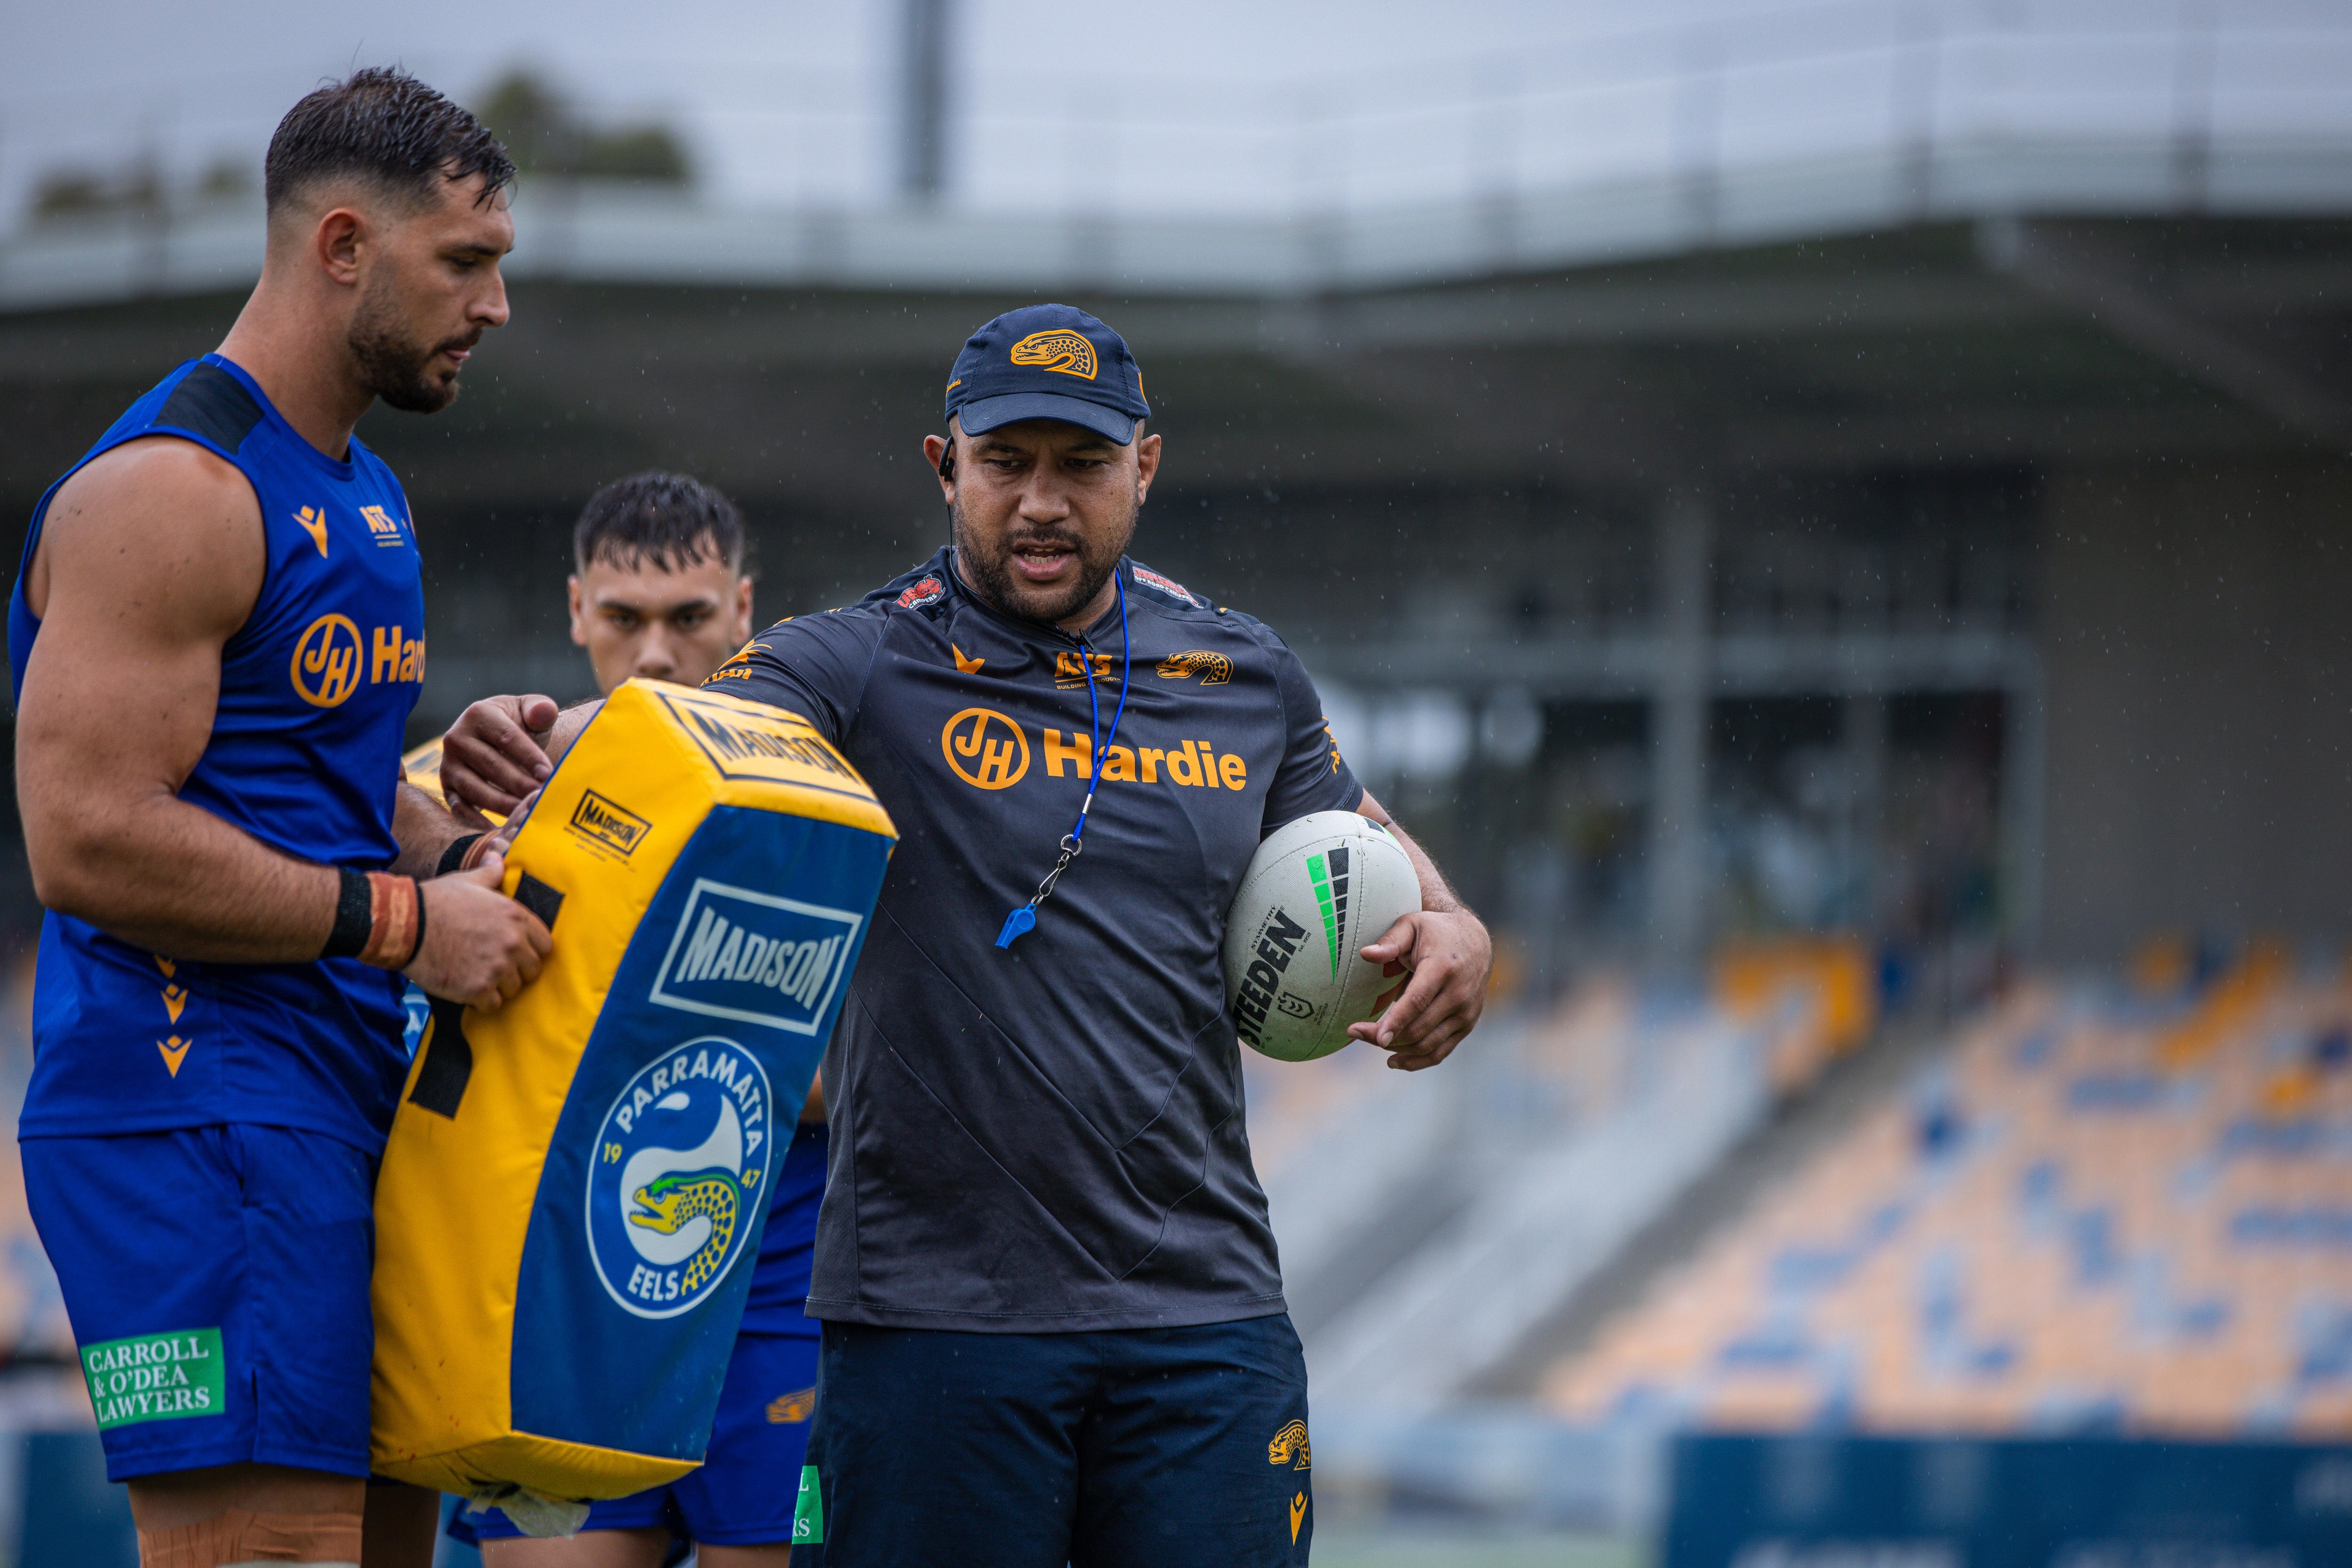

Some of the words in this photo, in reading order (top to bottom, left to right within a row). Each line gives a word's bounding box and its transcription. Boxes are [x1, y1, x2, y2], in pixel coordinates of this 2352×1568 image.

[359, 505, 397, 533] ATS
[909, 594, 937, 609] CAMPERS
[1147, 579, 1164, 589] ROAD
[1165, 586, 1193, 602] CAMPERS
[1054, 652, 1112, 677] ATS
[1057, 681, 1086, 690] BUILDING
[686, 708, 862, 785] MADISON
[1044, 728, 1247, 791] Hardie
[579, 798, 643, 847] MADISON
[1251, 904, 1276, 950] SYMMETRY
[674, 905, 840, 1011] MADISON
[615, 1049, 763, 1158] PARRAMATTA
[603, 1142, 622, 1164] 19
[740, 1168, 762, 1189] 47
[627, 1263, 679, 1301] EELS
[89, 1336, 209, 1373] CARROLL
[94, 1376, 106, 1399] &
[110, 1363, 190, 1394] O'DEA
[96, 1386, 211, 1423] LAWYERS
